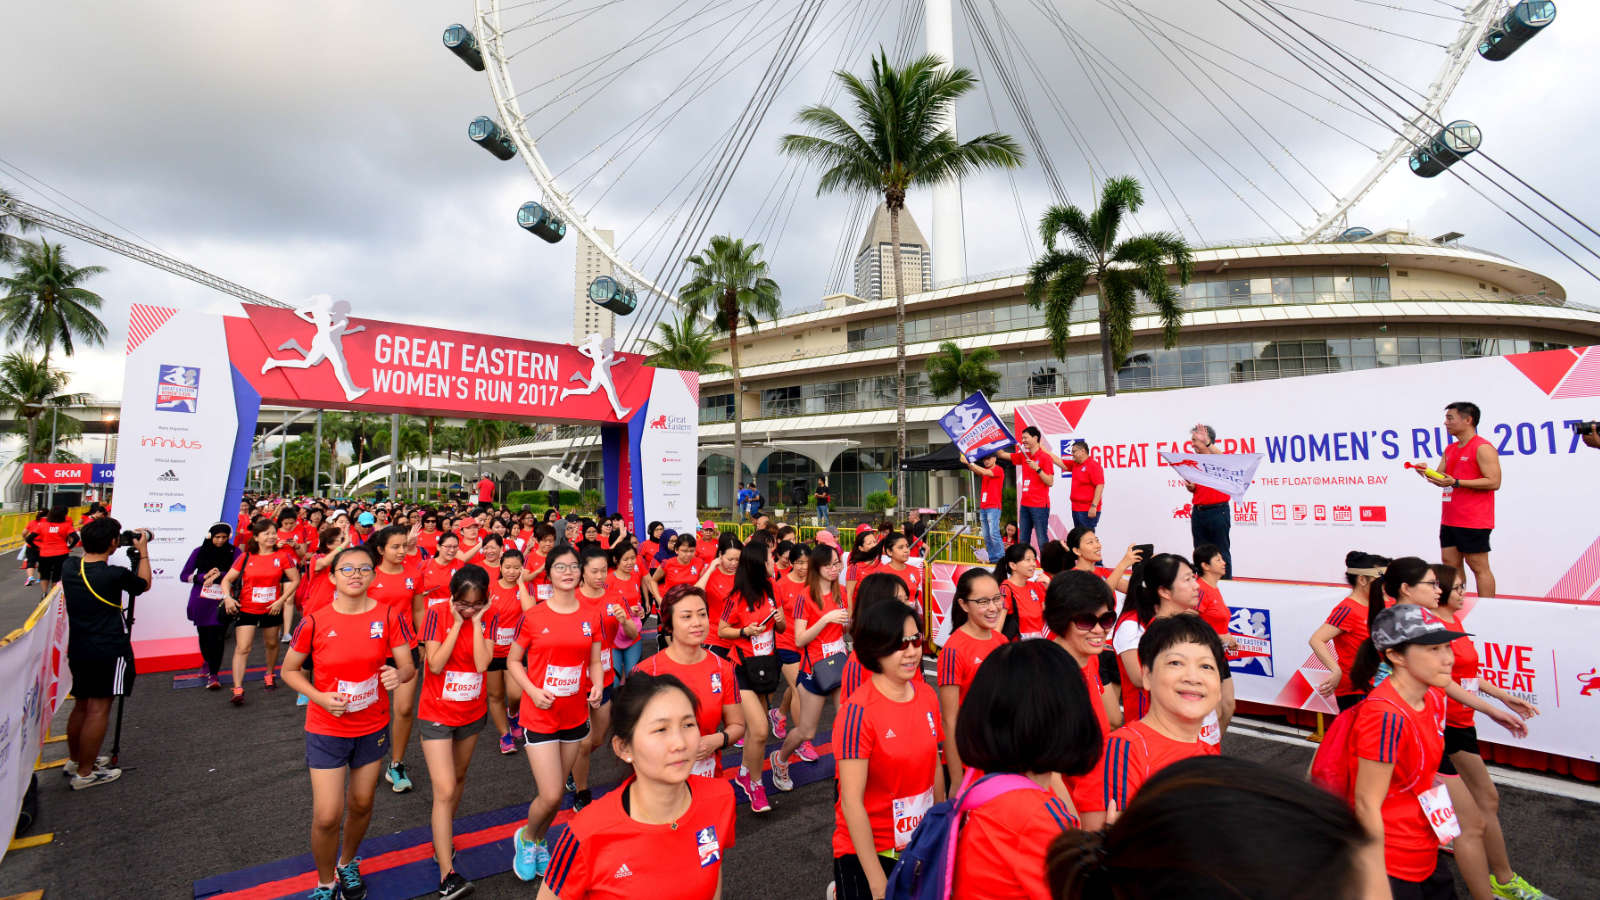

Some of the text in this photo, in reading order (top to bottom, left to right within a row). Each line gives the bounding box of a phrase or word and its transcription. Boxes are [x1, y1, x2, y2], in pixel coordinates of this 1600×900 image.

[374, 334, 559, 381] GREAT EASTERN
[372, 368, 559, 406] WOMEN'S RUN 2017
[1090, 419, 1583, 469] GREAT EARN WOMEN'S RU 2017
[54, 469, 115, 478] 5KM 10
[1261, 476, 1280, 487] THE
[1368, 475, 1388, 486] BAY
[1234, 512, 1258, 523] GREAT
[1478, 642, 1535, 675] IVE
[1478, 668, 1536, 693] REAT
